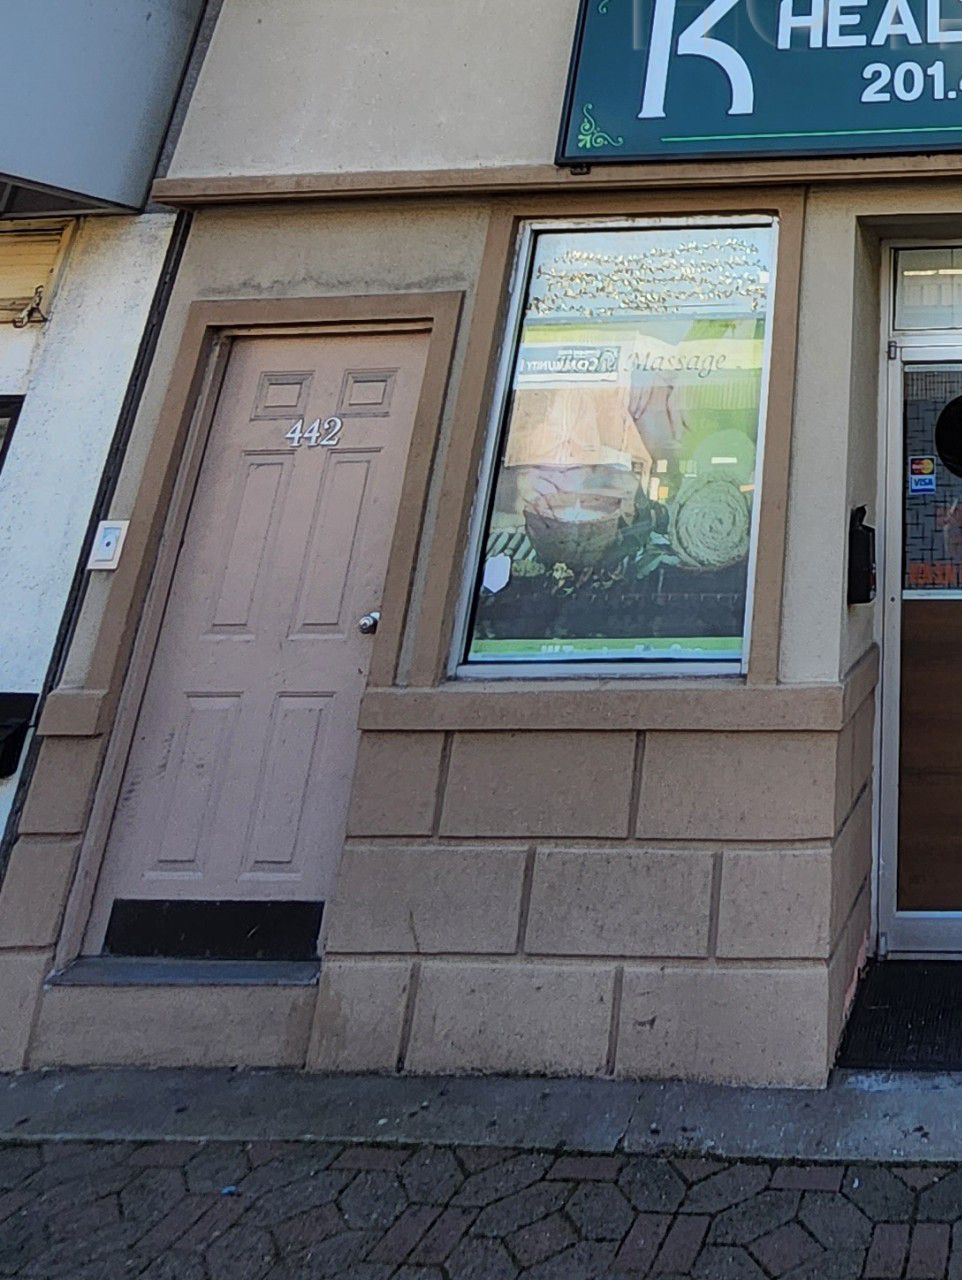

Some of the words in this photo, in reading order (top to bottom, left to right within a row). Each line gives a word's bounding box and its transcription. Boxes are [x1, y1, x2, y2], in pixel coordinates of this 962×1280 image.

[624, 351, 726, 378] Massage
[285, 417, 342, 447] 442
[914, 477, 933, 487] VISA
